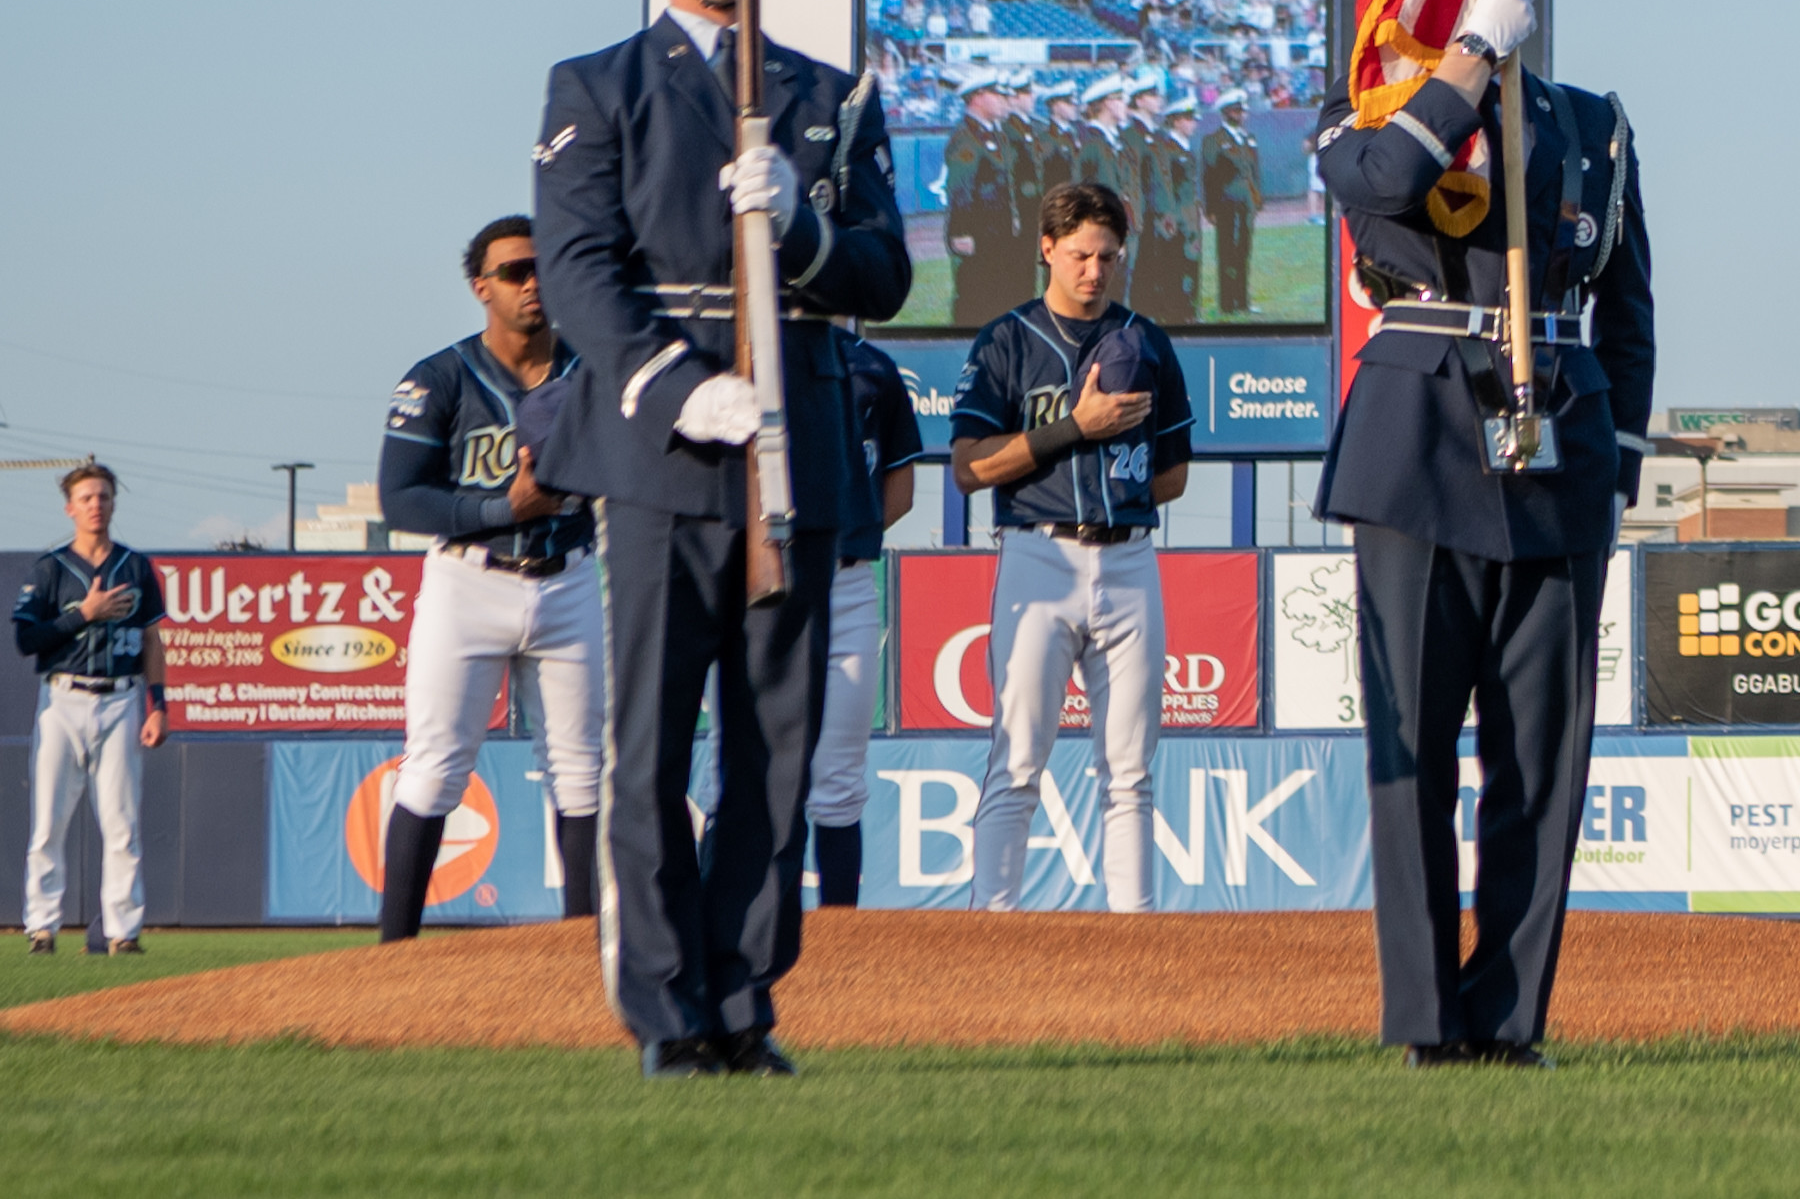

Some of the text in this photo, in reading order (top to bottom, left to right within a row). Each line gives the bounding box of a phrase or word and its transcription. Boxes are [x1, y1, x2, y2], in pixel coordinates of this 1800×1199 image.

[1229, 372, 1307, 394] Choose
[1228, 397, 1319, 418] Smarter.
[1109, 442, 1149, 483] 26
[160, 565, 347, 623] Wertz
[358, 566, 406, 623] &
[164, 647, 264, 668] 02-658-5186
[281, 640, 335, 658] Since
[343, 640, 387, 658] 1926
[163, 683, 218, 705] oofing
[218, 683, 236, 701] &
[237, 683, 308, 704] Chimney
[1161, 694, 1219, 710] PPLIES
[186, 703, 258, 726] Masonry
[268, 703, 334, 721] Outdoor
[1730, 803, 1792, 826] PEST
[876, 768, 1317, 887] BANK
